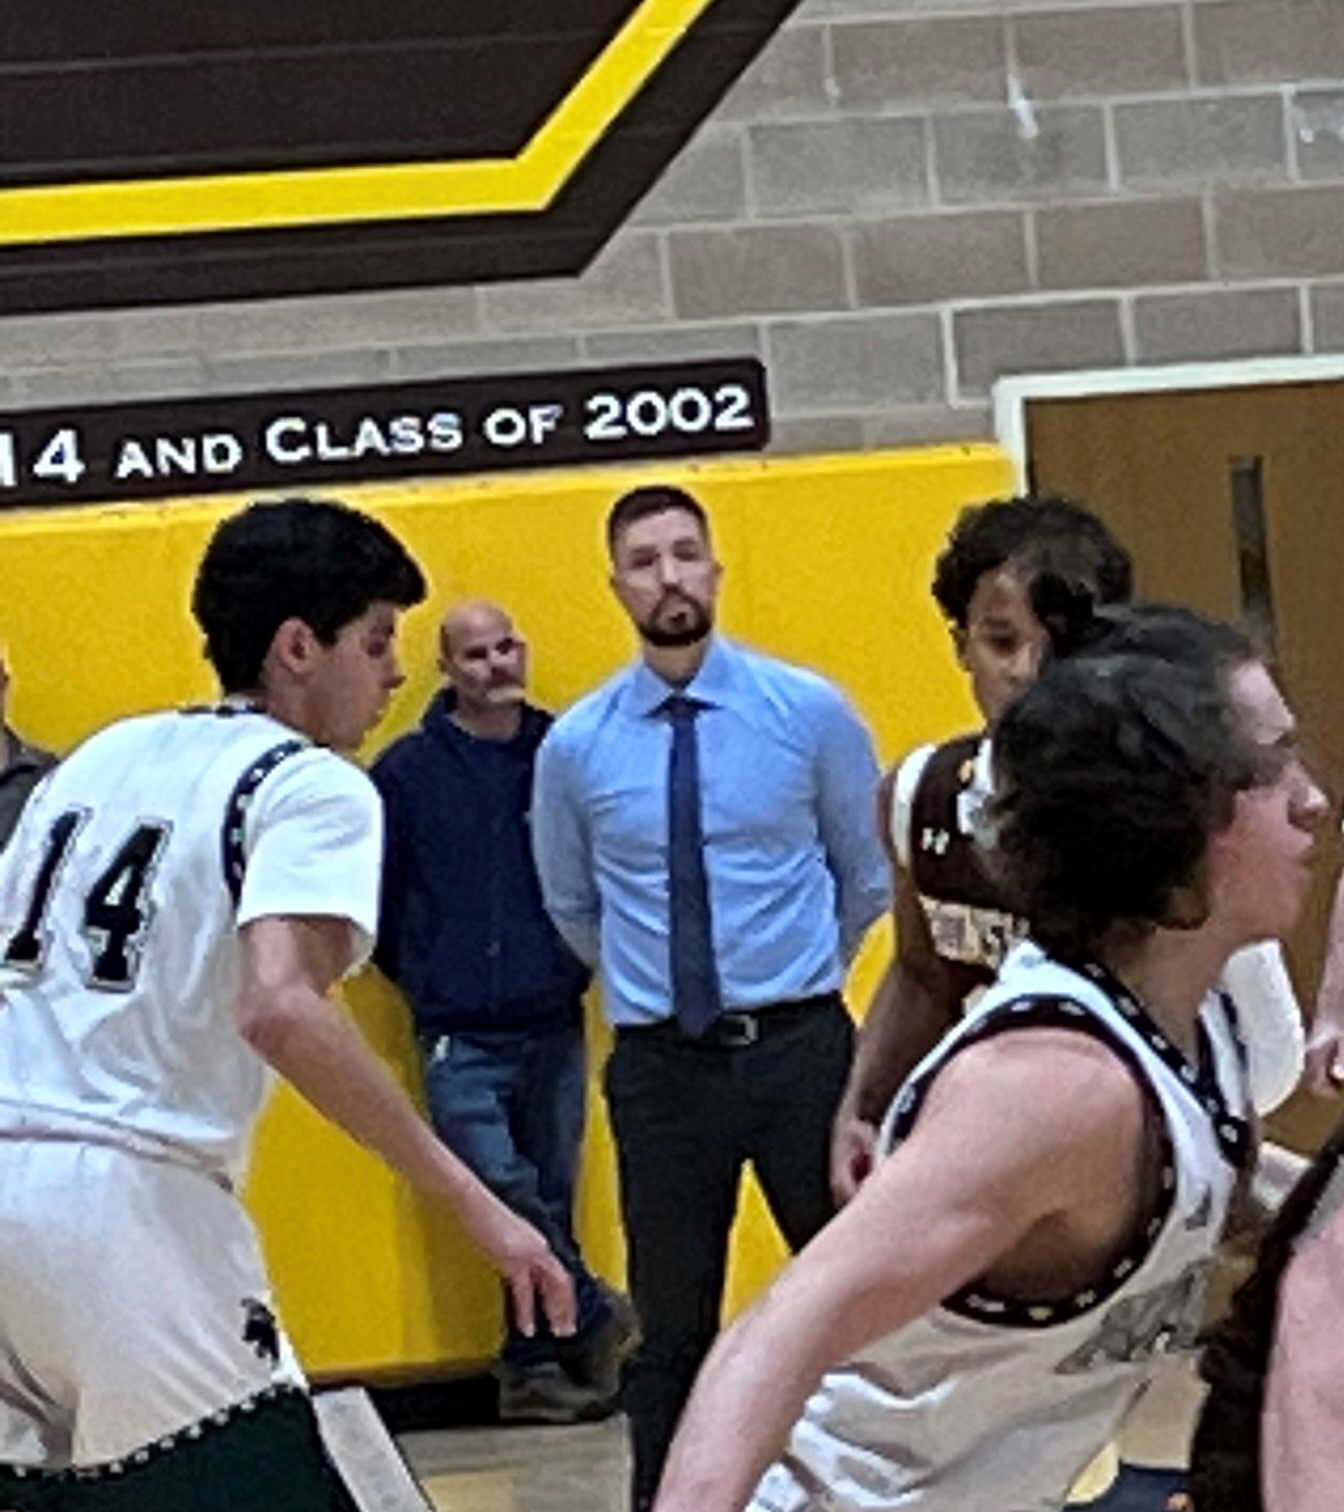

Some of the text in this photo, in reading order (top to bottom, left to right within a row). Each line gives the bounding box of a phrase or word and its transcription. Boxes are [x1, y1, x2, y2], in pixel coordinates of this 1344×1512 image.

[115, 435, 242, 480] AND
[264, 412, 464, 464] CLASS
[483, 404, 562, 446] OF
[584, 385, 753, 442] 2002
[3, 808, 174, 990] 14
